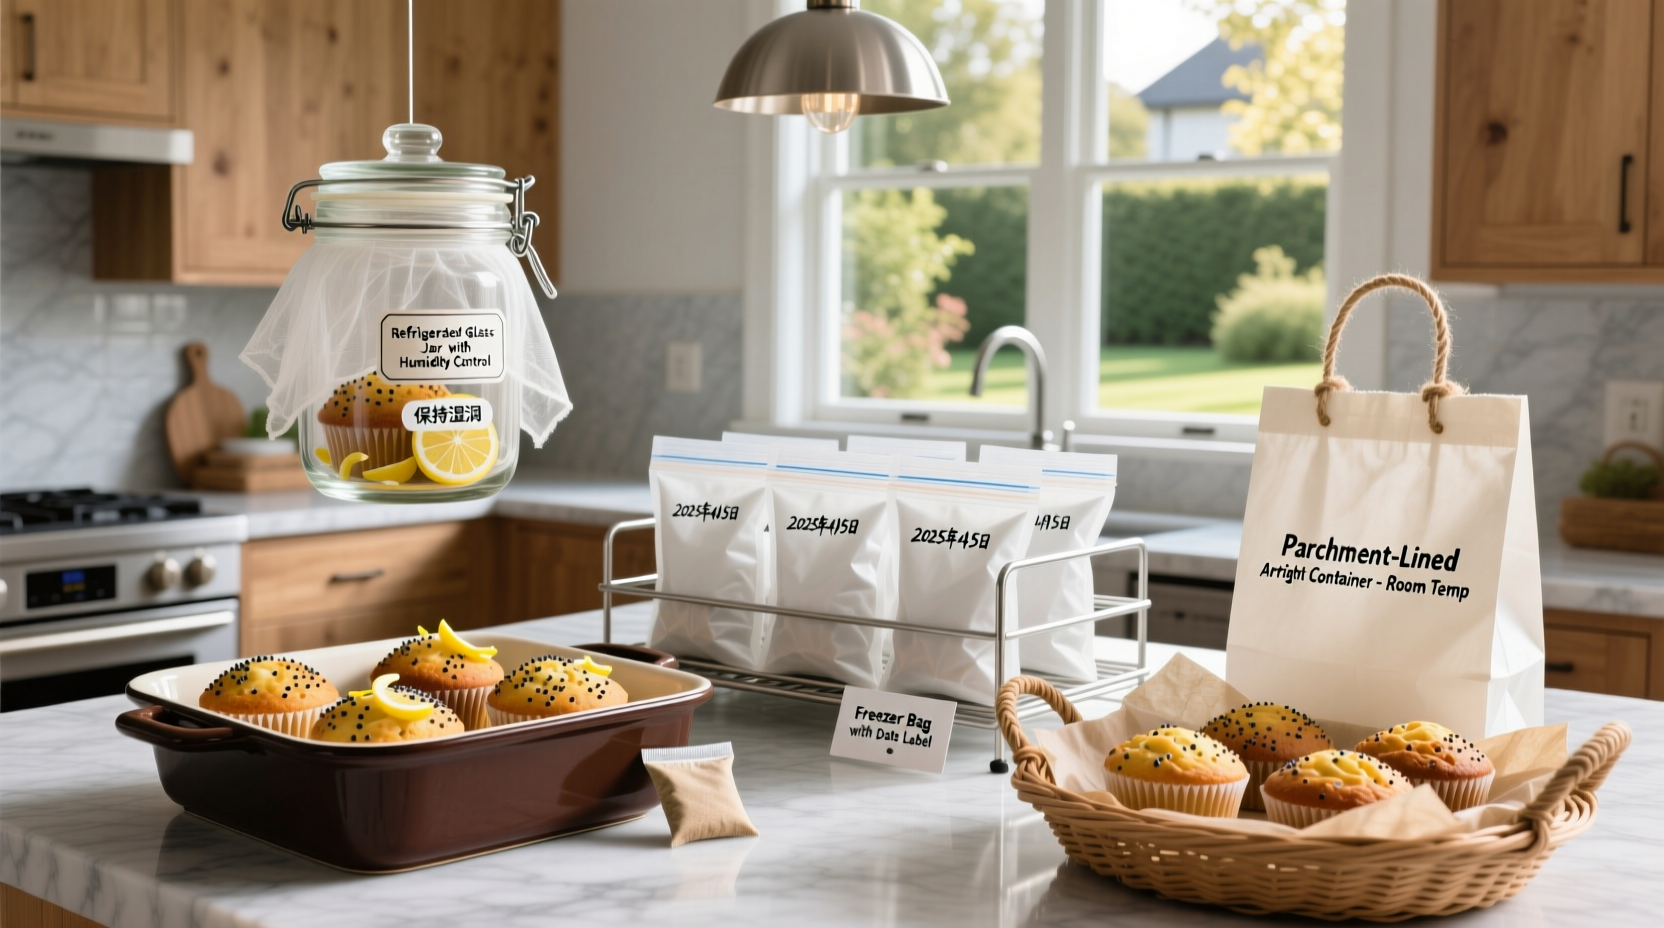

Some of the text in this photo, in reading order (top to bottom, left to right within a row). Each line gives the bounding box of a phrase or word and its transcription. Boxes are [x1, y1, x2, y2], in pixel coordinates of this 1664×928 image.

[448, 341, 471, 354] with
[1281, 533, 1461, 573] Parchment-Lined
[1308, 566, 1373, 589] Container
[1385, 574, 1426, 595] Room
[1430, 579, 1470, 603] Temp
[906, 712, 932, 735] Bag
[849, 724, 873, 739] with
[902, 730, 933, 748] Label
